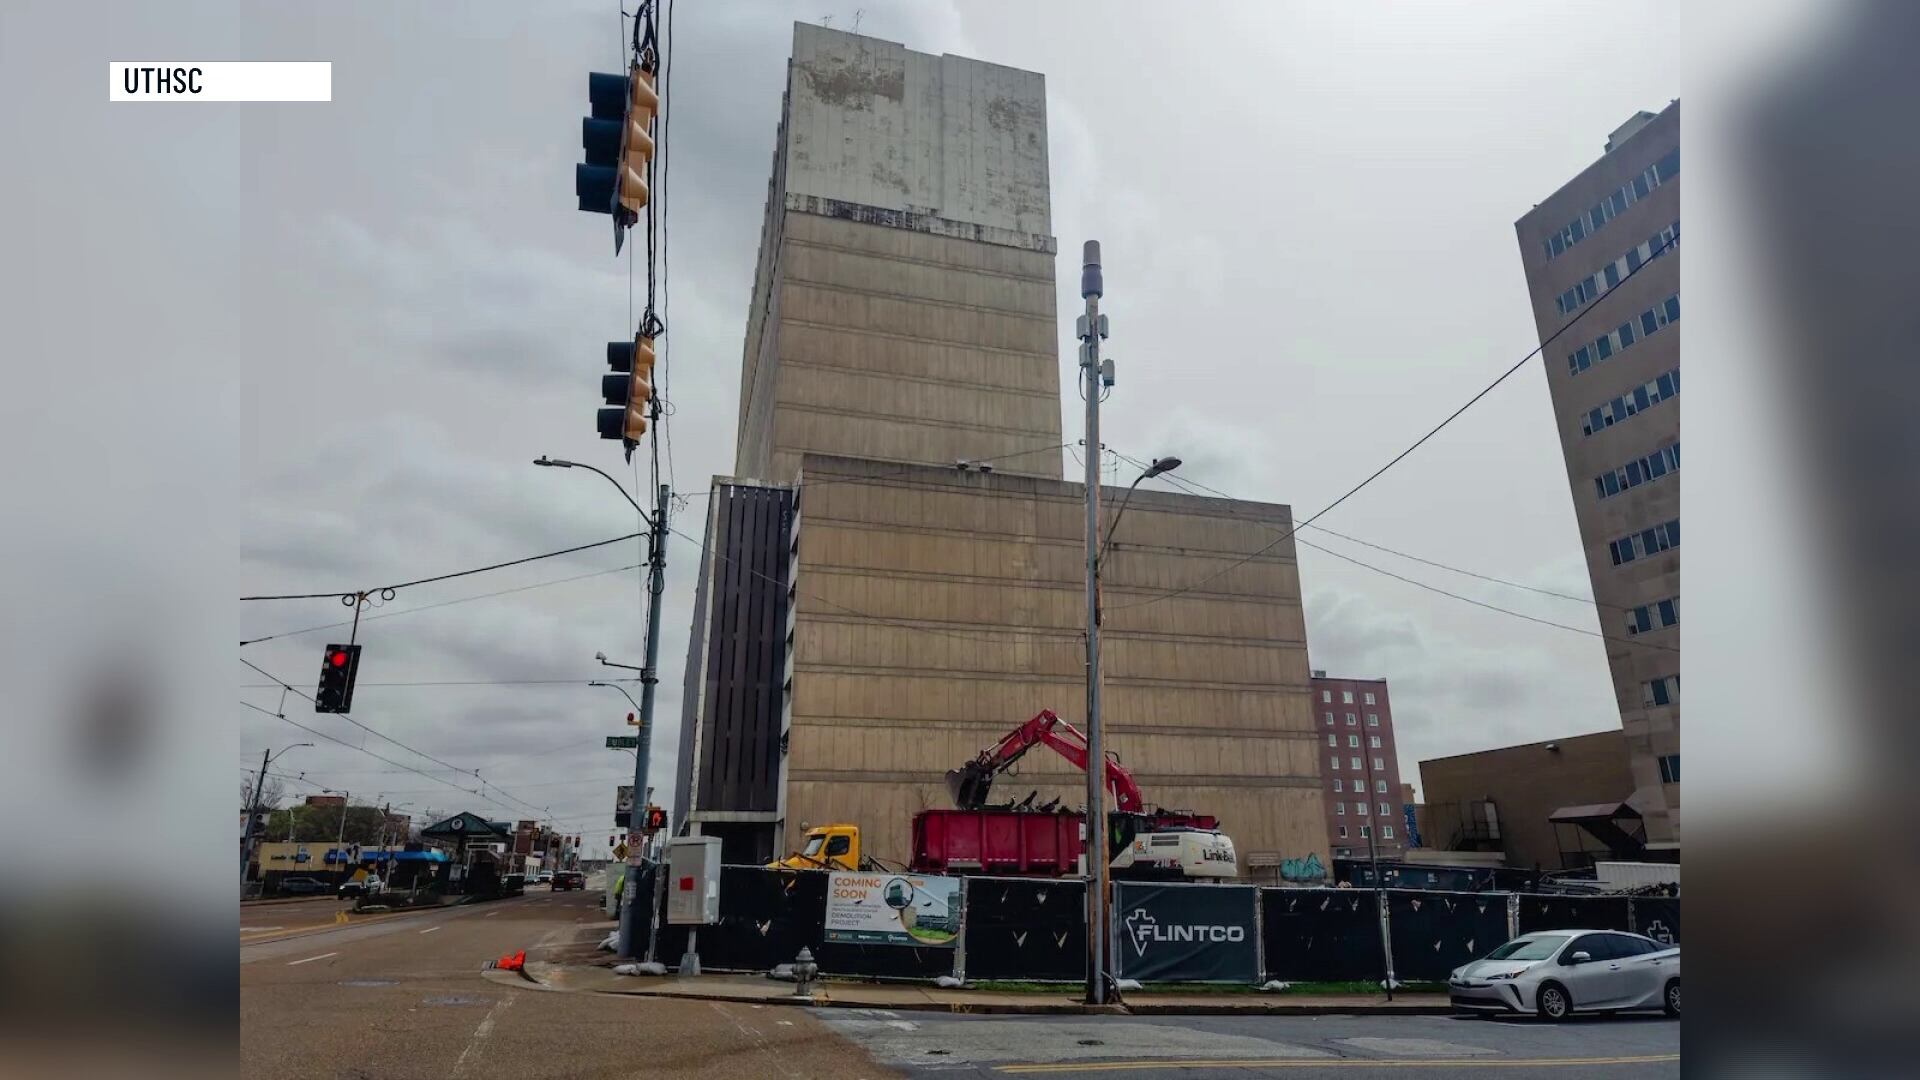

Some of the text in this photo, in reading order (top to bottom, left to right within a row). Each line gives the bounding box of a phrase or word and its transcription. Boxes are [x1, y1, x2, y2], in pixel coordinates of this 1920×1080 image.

[834, 877, 882, 888] COMING
[833, 888, 868, 899] SOON
[831, 912, 872, 920] DEMOLITION
[831, 918, 860, 927] PROJECT
[1137, 924, 1245, 943] FLINTCO
